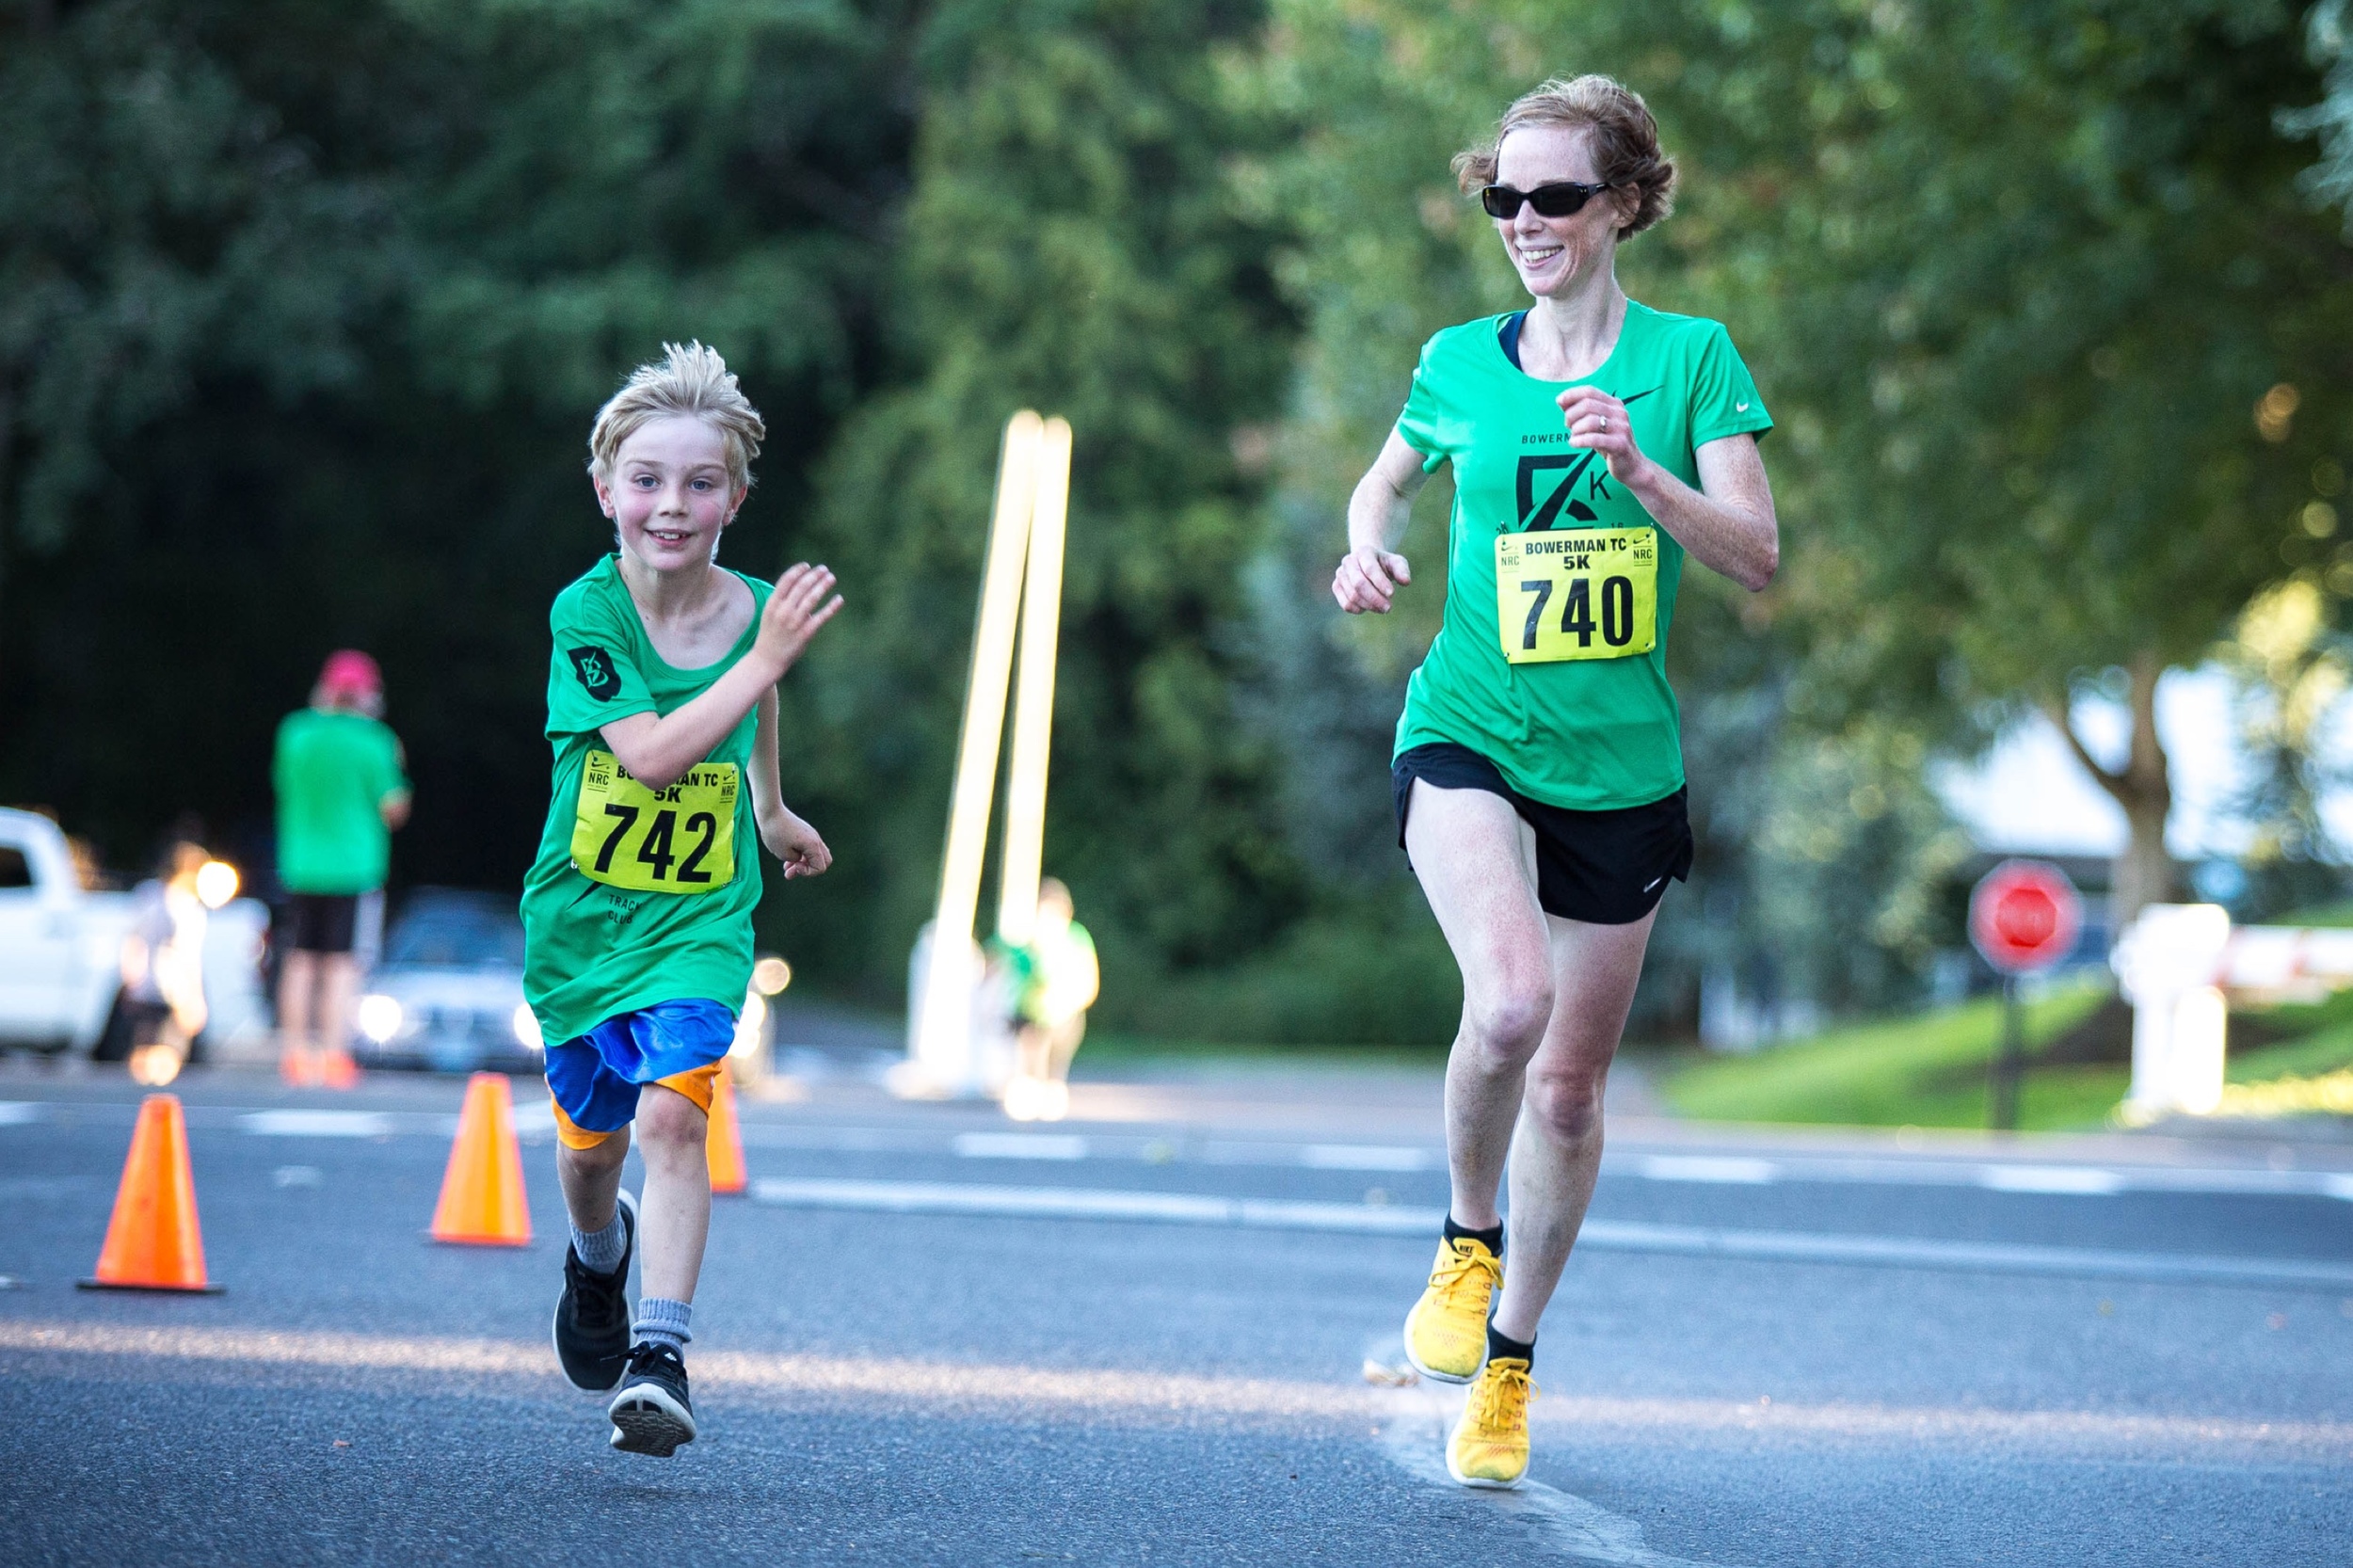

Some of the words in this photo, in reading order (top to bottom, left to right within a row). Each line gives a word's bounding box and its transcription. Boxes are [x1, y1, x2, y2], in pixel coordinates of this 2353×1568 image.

[1526, 539, 1606, 555] BOWERMAN
[1610, 537, 1626, 552] TC
[1501, 555, 1520, 567] NRC
[1563, 554, 1591, 570] 5K
[1634, 549, 1653, 560] NRC
[1521, 576, 1633, 649] 740
[588, 772, 610, 786] NRC
[704, 773, 719, 787] TC
[653, 786, 682, 803] 5K
[721, 785, 736, 797] NRC
[594, 803, 717, 884] 742
